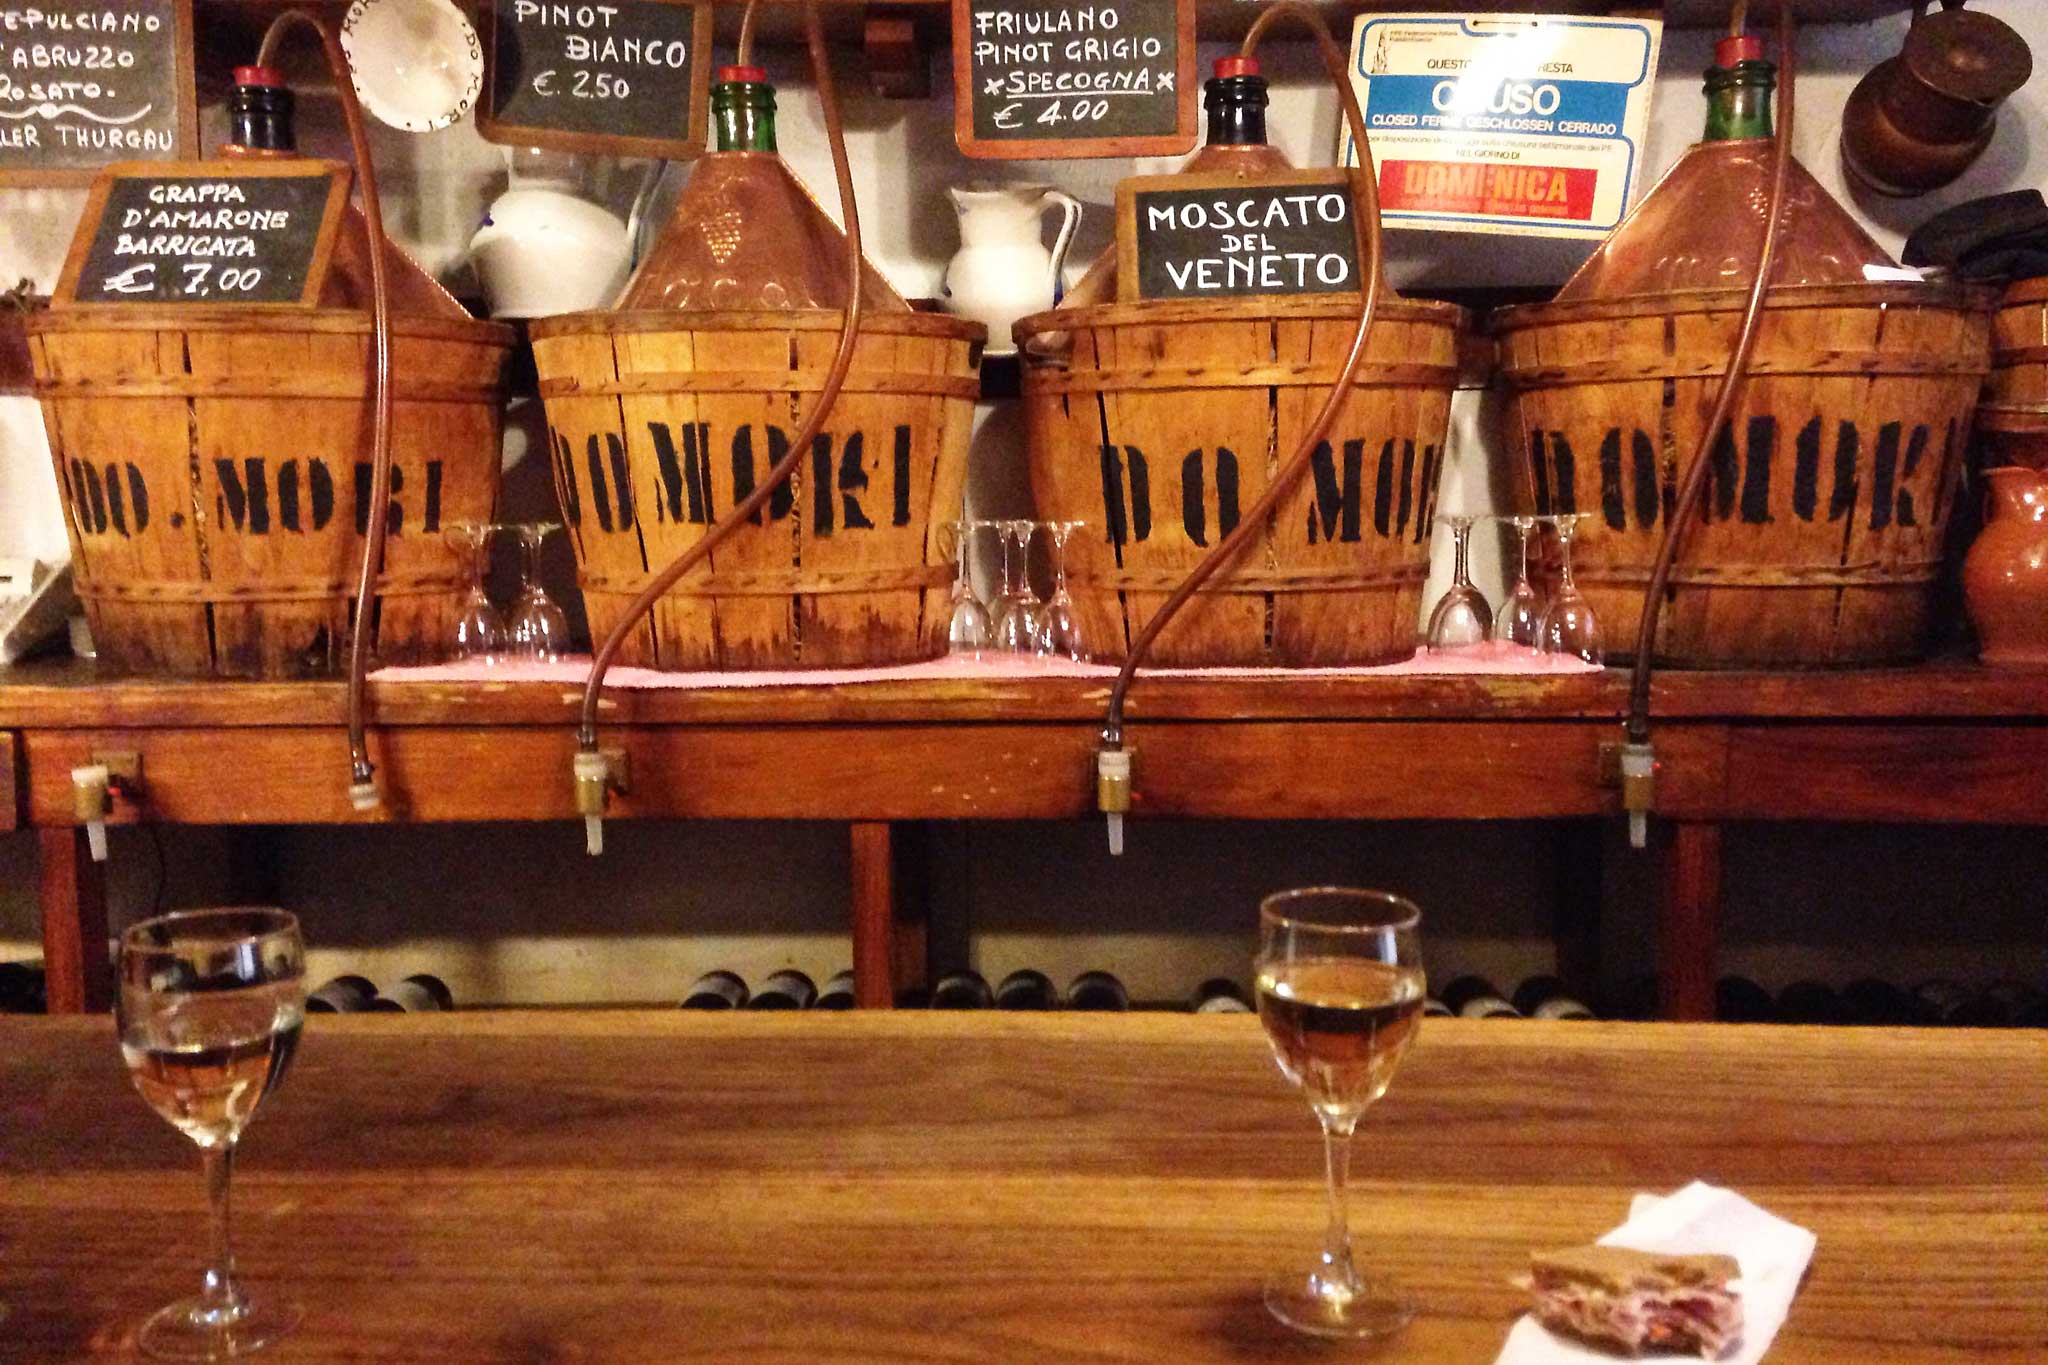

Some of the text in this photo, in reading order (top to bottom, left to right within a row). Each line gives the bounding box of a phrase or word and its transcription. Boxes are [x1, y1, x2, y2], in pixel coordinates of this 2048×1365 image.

[0, 8, 160, 33] EPULCIANO
[514, 0, 618, 28] PINOT
[975, 7, 1119, 35] FRIULANO
[565, 34, 686, 68] BIANCO
[975, 37, 1161, 65] PINOT GRIGIO
[572, 70, 630, 98] 2.50
[1432, 80, 1561, 116] CUSO
[993, 100, 1109, 129] € 4.00
[1372, 113, 1419, 127] CLOSED
[1466, 116, 1553, 132] GESCHLOSSEN
[1558, 121, 1617, 136] CERRADO
[0, 124, 172, 151] LER THURGAU
[1475, 149, 1509, 160] GIORNO
[1511, 151, 1520, 160] DI
[149, 183, 245, 204] GRAPPA
[122, 207, 289, 231] D'AMARONE
[1148, 193, 1346, 231] MOSCATO
[1220, 233, 1276, 252] DEL
[103, 263, 156, 293] €
[1165, 253, 1349, 290] VENETO
[1099, 445, 1240, 547] DO
